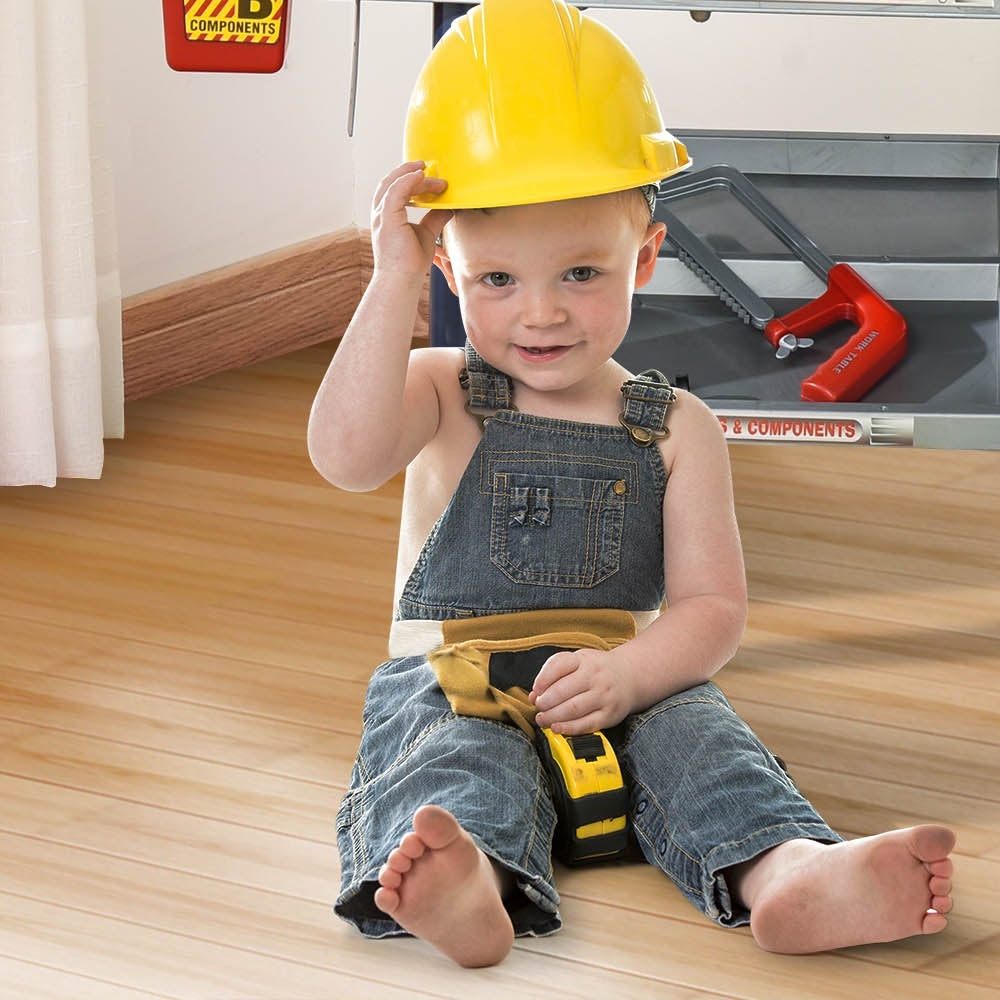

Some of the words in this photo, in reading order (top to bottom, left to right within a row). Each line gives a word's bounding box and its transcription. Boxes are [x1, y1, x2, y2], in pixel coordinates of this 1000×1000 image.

[190, 19, 276, 35] COMPONENTS
[856, 330, 879, 351] WORK
[832, 351, 857, 374] TABLE
[732, 418, 742, 434] &
[747, 419, 856, 438] COMPONENTS
